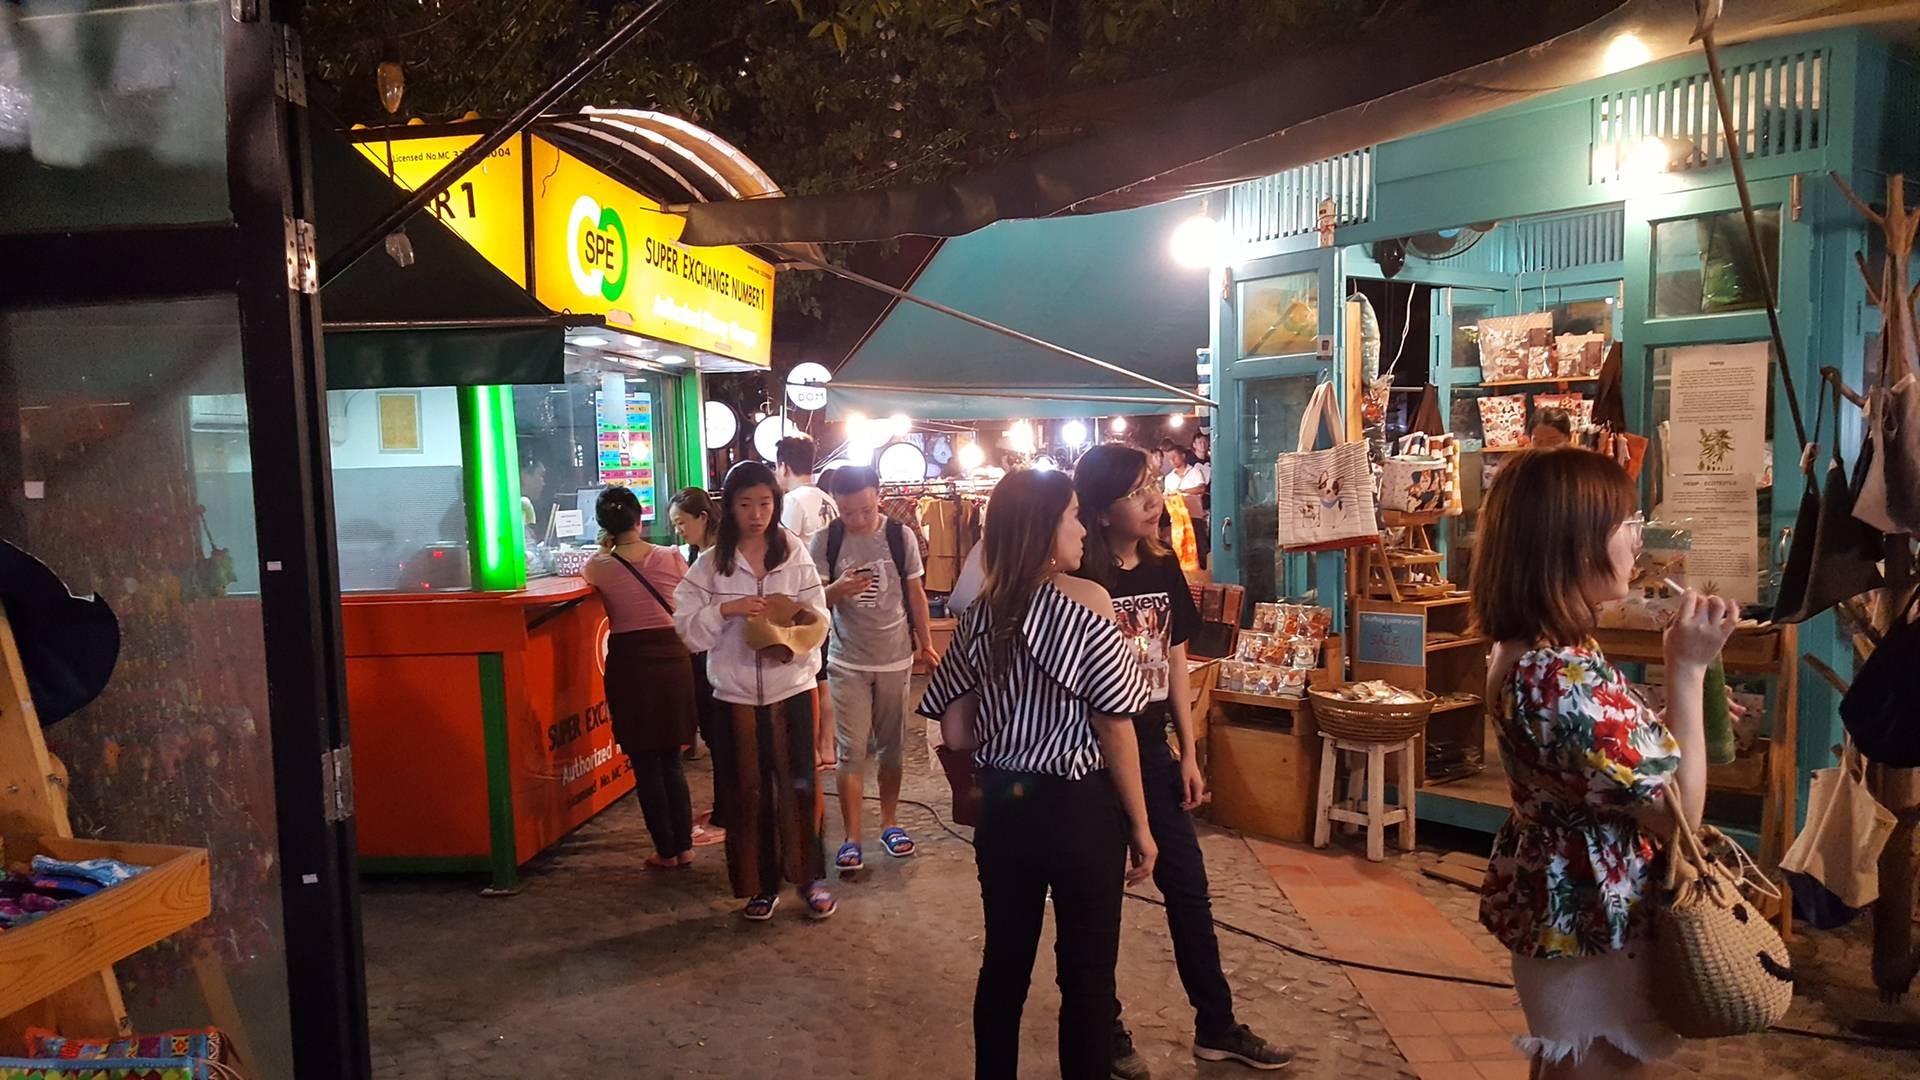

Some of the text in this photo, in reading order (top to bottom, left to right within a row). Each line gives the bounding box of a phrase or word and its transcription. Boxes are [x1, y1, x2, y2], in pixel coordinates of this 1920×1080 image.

[393, 153, 423, 162] Licensed
[461, 182, 476, 218] 1
[586, 230, 615, 269] SPE
[645, 237, 679, 274] SUPER
[683, 255, 730, 295] EXCHANGE
[731, 278, 760, 309] NUMBER
[548, 714, 581, 751] SUPER
[563, 740, 612, 786] Authorized
